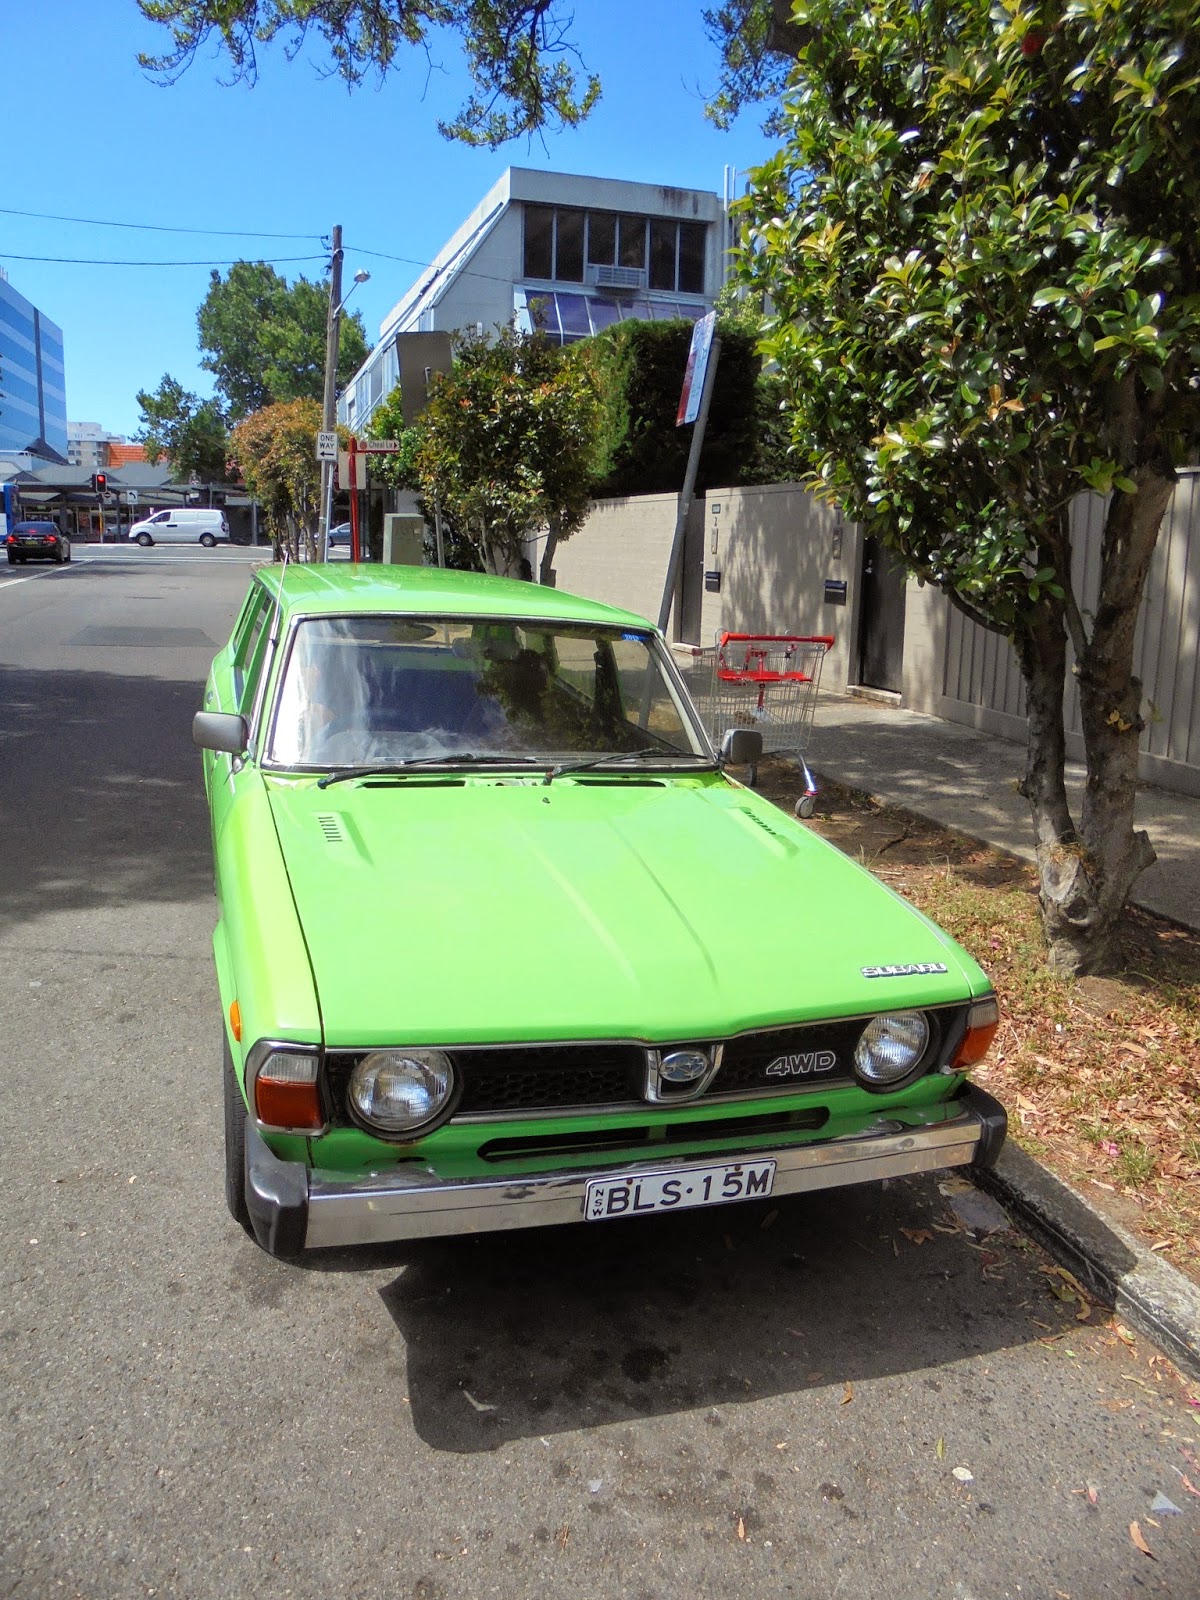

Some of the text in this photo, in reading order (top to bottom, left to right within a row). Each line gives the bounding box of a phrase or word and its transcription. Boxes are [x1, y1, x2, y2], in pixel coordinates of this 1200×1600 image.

[320, 434, 335, 442] ONE
[861, 962, 948, 978] SUBARU
[765, 1050, 836, 1076] 4WD
[592, 1188, 605, 1216] NSW
